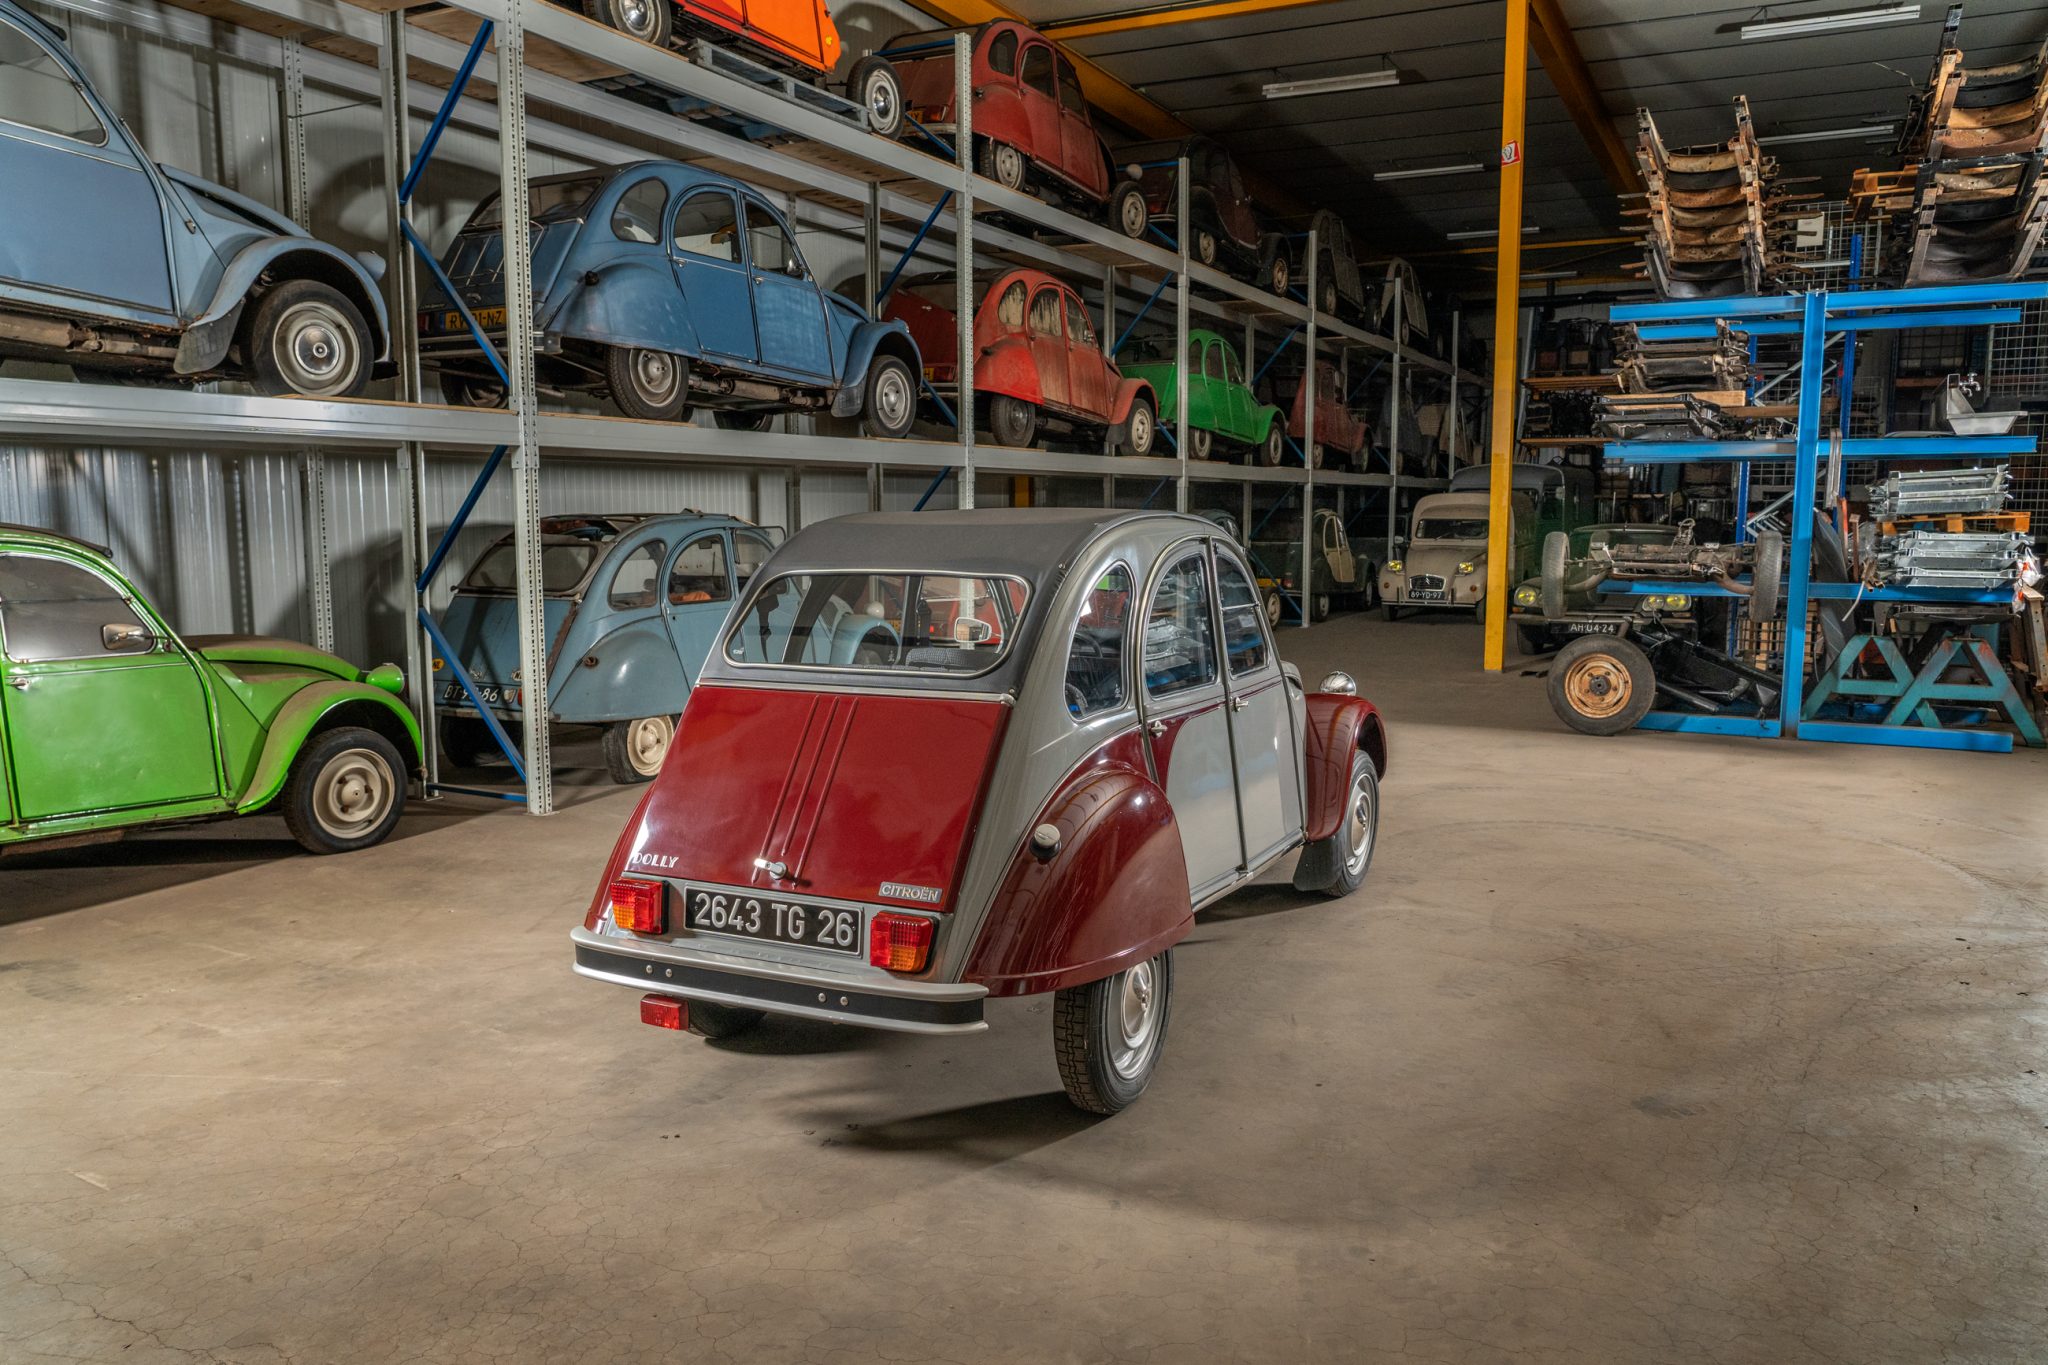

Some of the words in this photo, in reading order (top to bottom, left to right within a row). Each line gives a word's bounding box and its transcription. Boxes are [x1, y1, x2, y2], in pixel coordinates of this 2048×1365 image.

[632, 852, 679, 868] DOLLY
[882, 885, 939, 901] CITROËN
[695, 892, 742, 934] 2643
[771, 902, 805, 940] TG
[817, 909, 854, 947] 26
